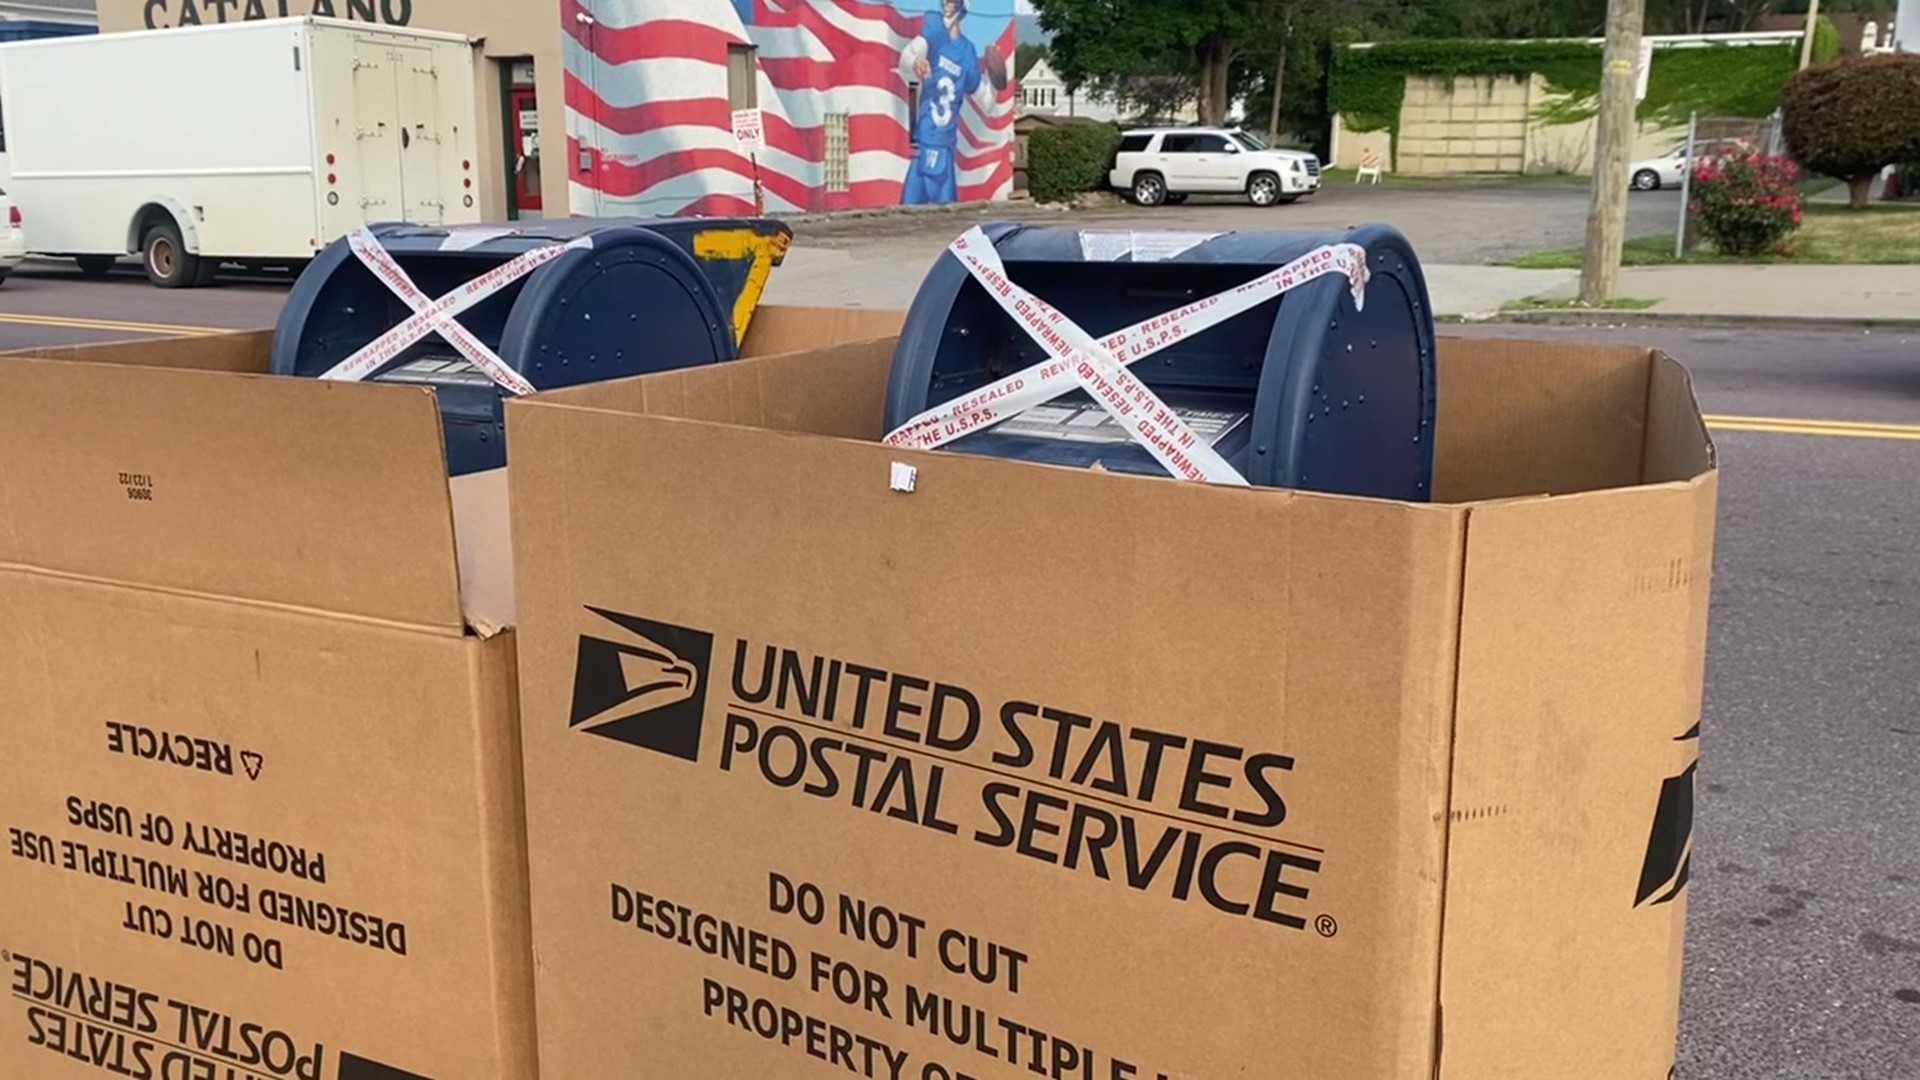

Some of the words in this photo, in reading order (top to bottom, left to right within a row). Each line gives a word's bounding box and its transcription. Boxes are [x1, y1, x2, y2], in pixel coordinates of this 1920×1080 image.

[930, 76, 956, 128] 3
[737, 128, 760, 141] ONLY
[1275, 276, 1294, 290] IN
[1298, 262, 1332, 280] THE
[342, 330, 399, 373] REWRAPPED
[407, 296, 457, 333] RESEALED
[1013, 299, 1073, 358] REWRAPPED
[1141, 296, 1219, 335] RESEALED
[1132, 325, 1188, 356] U.S.P.S.
[952, 379, 1024, 417] RESEALED
[1076, 362, 1133, 416] RESEALED
[1116, 370, 1155, 413] U.S.P.S.
[945, 408, 998, 435] U.S.P.S.
[1153, 410, 1179, 436] THE
[1177, 432, 1196, 449] IN
[105, 720, 234, 776] RECYCLE
[731, 638, 981, 752] UNITED
[992, 700, 1295, 828] STATES
[719, 712, 959, 836] POSTAL
[66, 795, 133, 838] USPS
[140, 812, 174, 847] OF
[9, 827, 56, 865] USE
[182, 821, 326, 884] PROPERTY
[61, 840, 189, 898] MULTIPLE
[194, 870, 251, 914] FOR
[122, 901, 173, 939] CUT
[180, 916, 235, 957] NOT
[258, 888, 407, 956] DESIGNED
[769, 871, 825, 926] DO
[838, 893, 925, 959] NOT
[938, 929, 1028, 993] CUT
[242, 932, 283, 970] DO
[611, 882, 797, 981] DESIGNED
[810, 951, 893, 1020] FOR
[27, 1007, 154, 1080] STATES
[168, 1000, 323, 1080] POSTAL
[703, 977, 909, 1080] PROPERTY
